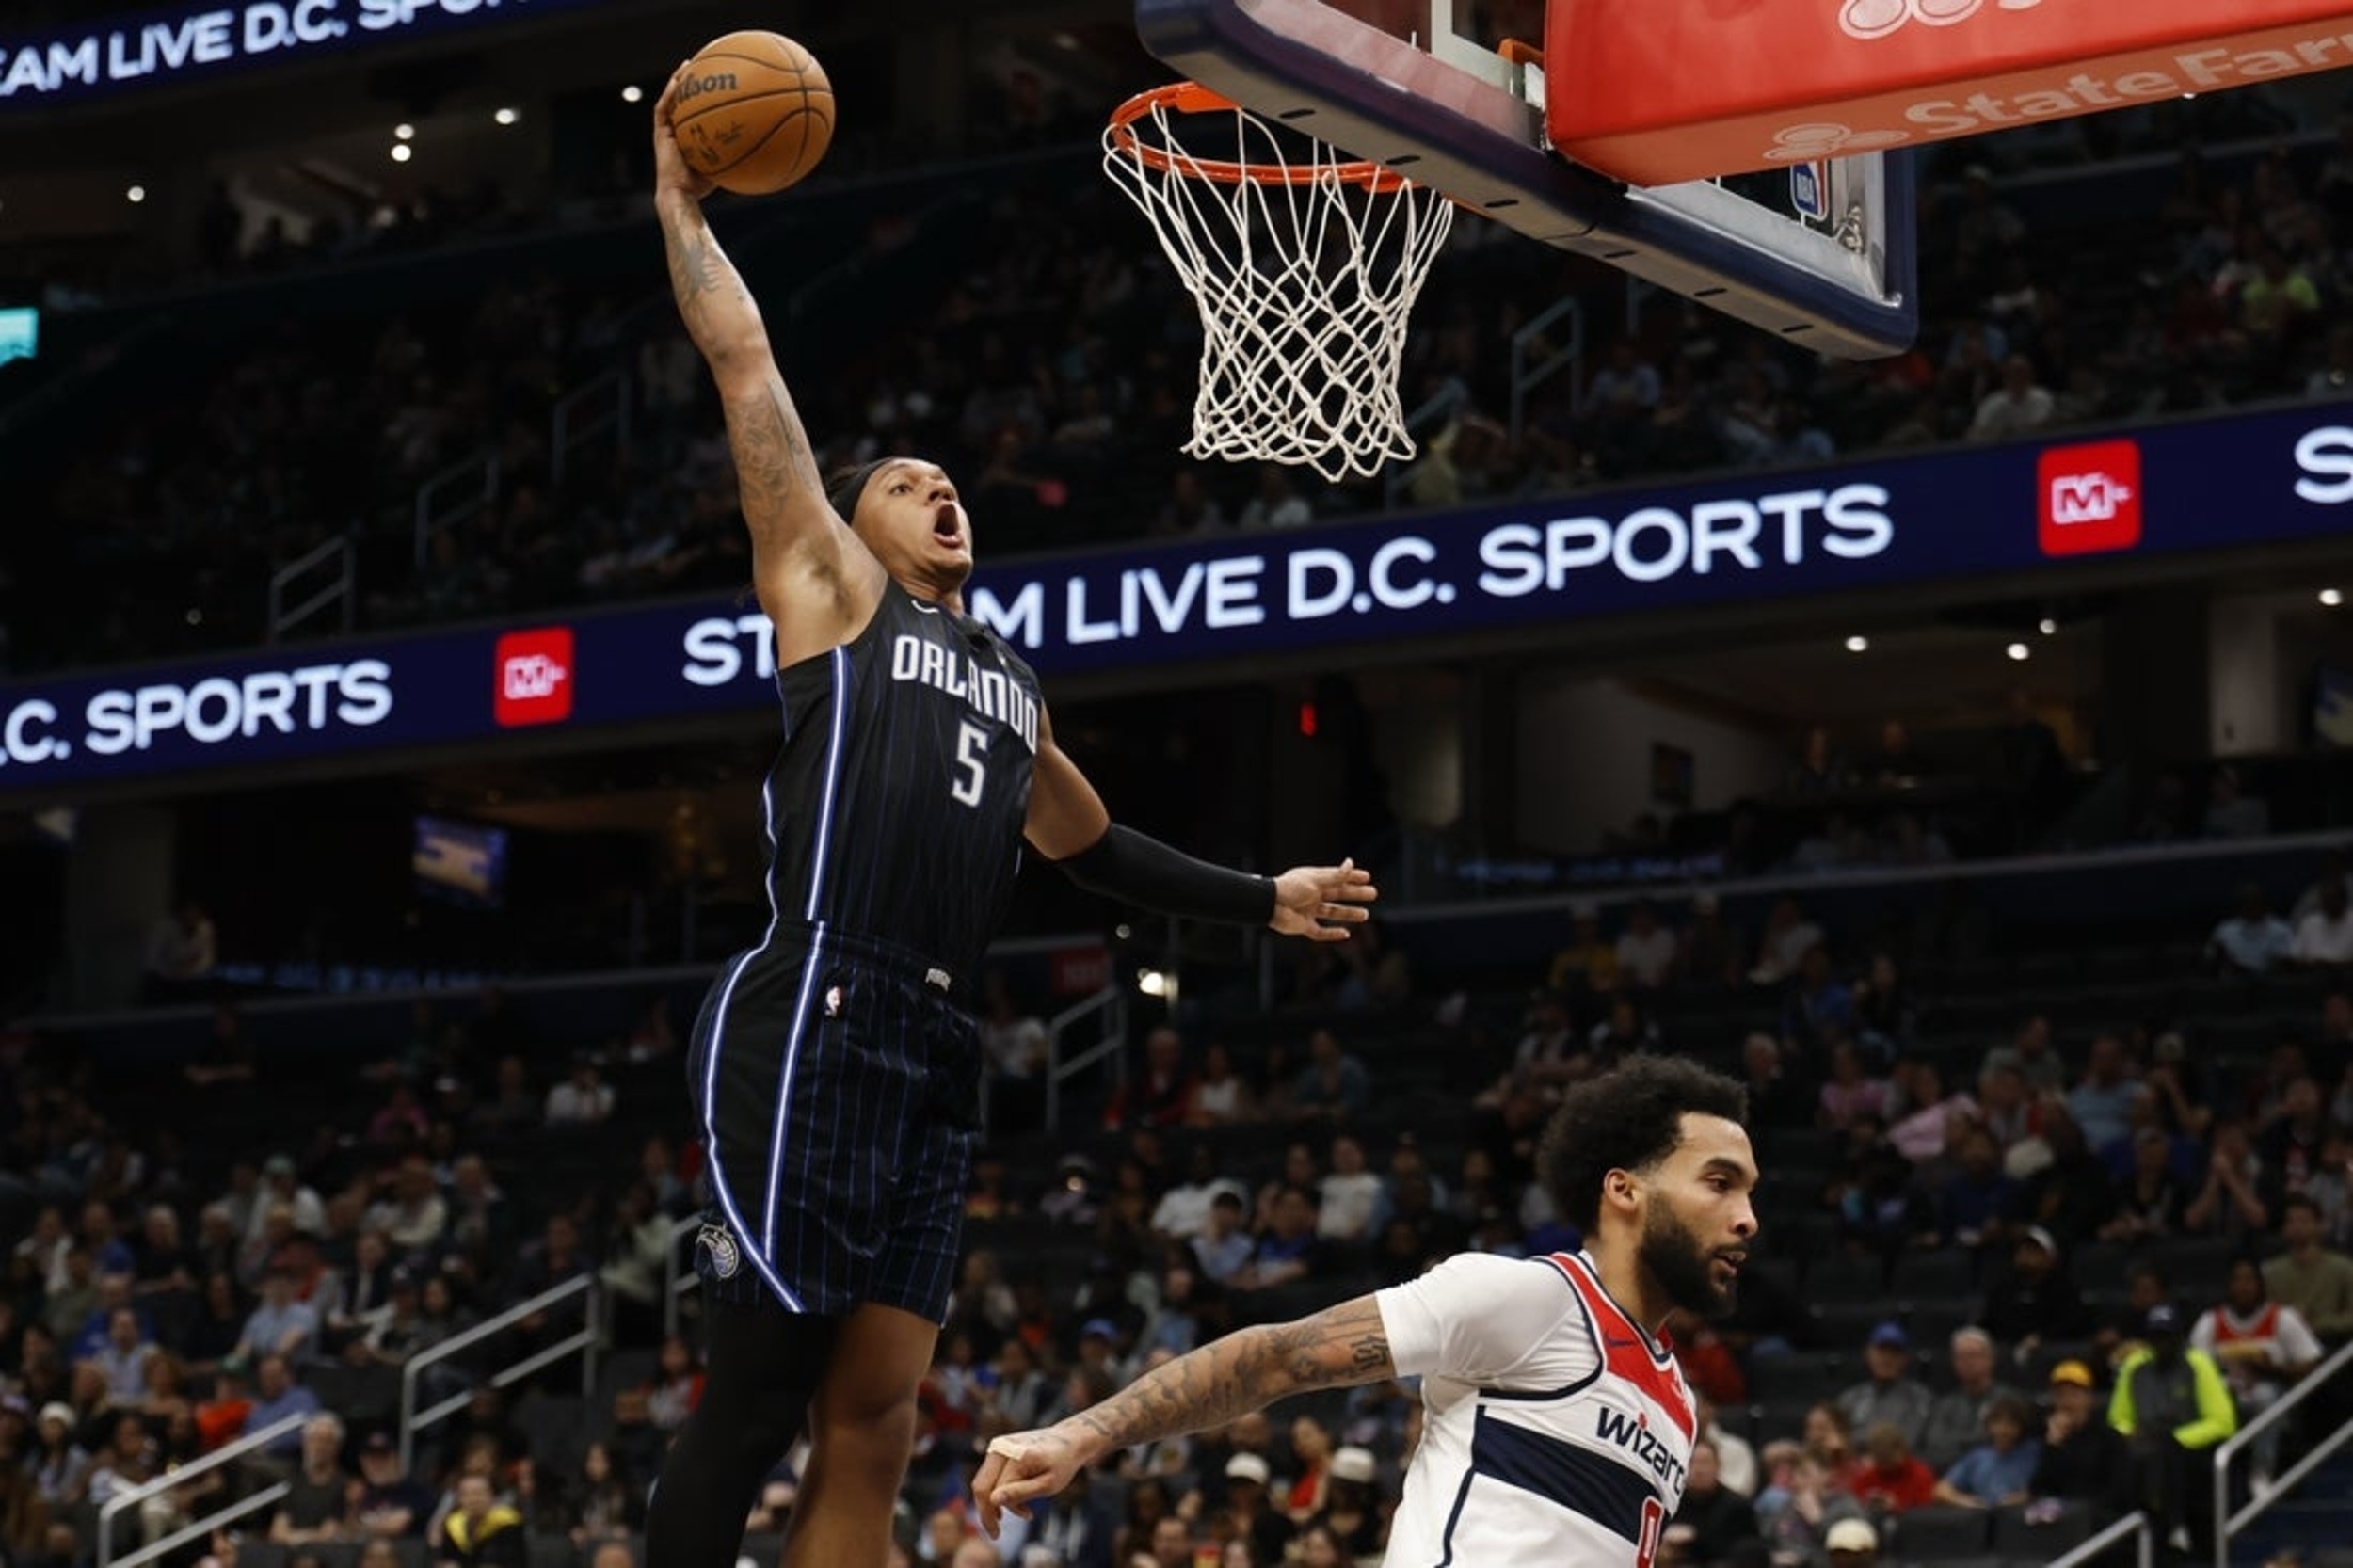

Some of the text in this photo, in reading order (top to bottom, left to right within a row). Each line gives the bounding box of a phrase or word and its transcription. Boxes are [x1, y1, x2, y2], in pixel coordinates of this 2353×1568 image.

[0, 36, 99, 97] AM
[108, 9, 234, 80] LIVE
[243, 0, 349, 54] D.C.
[1904, 33, 2353, 134] StateFar
[1066, 555, 1266, 645] LIVE
[1287, 536, 1457, 619] D.C.
[1478, 483, 1895, 598] SPORTS
[85, 658, 393, 755] SPORTS
[891, 634, 1037, 755] ORLANDO
[951, 718, 989, 808] 5
